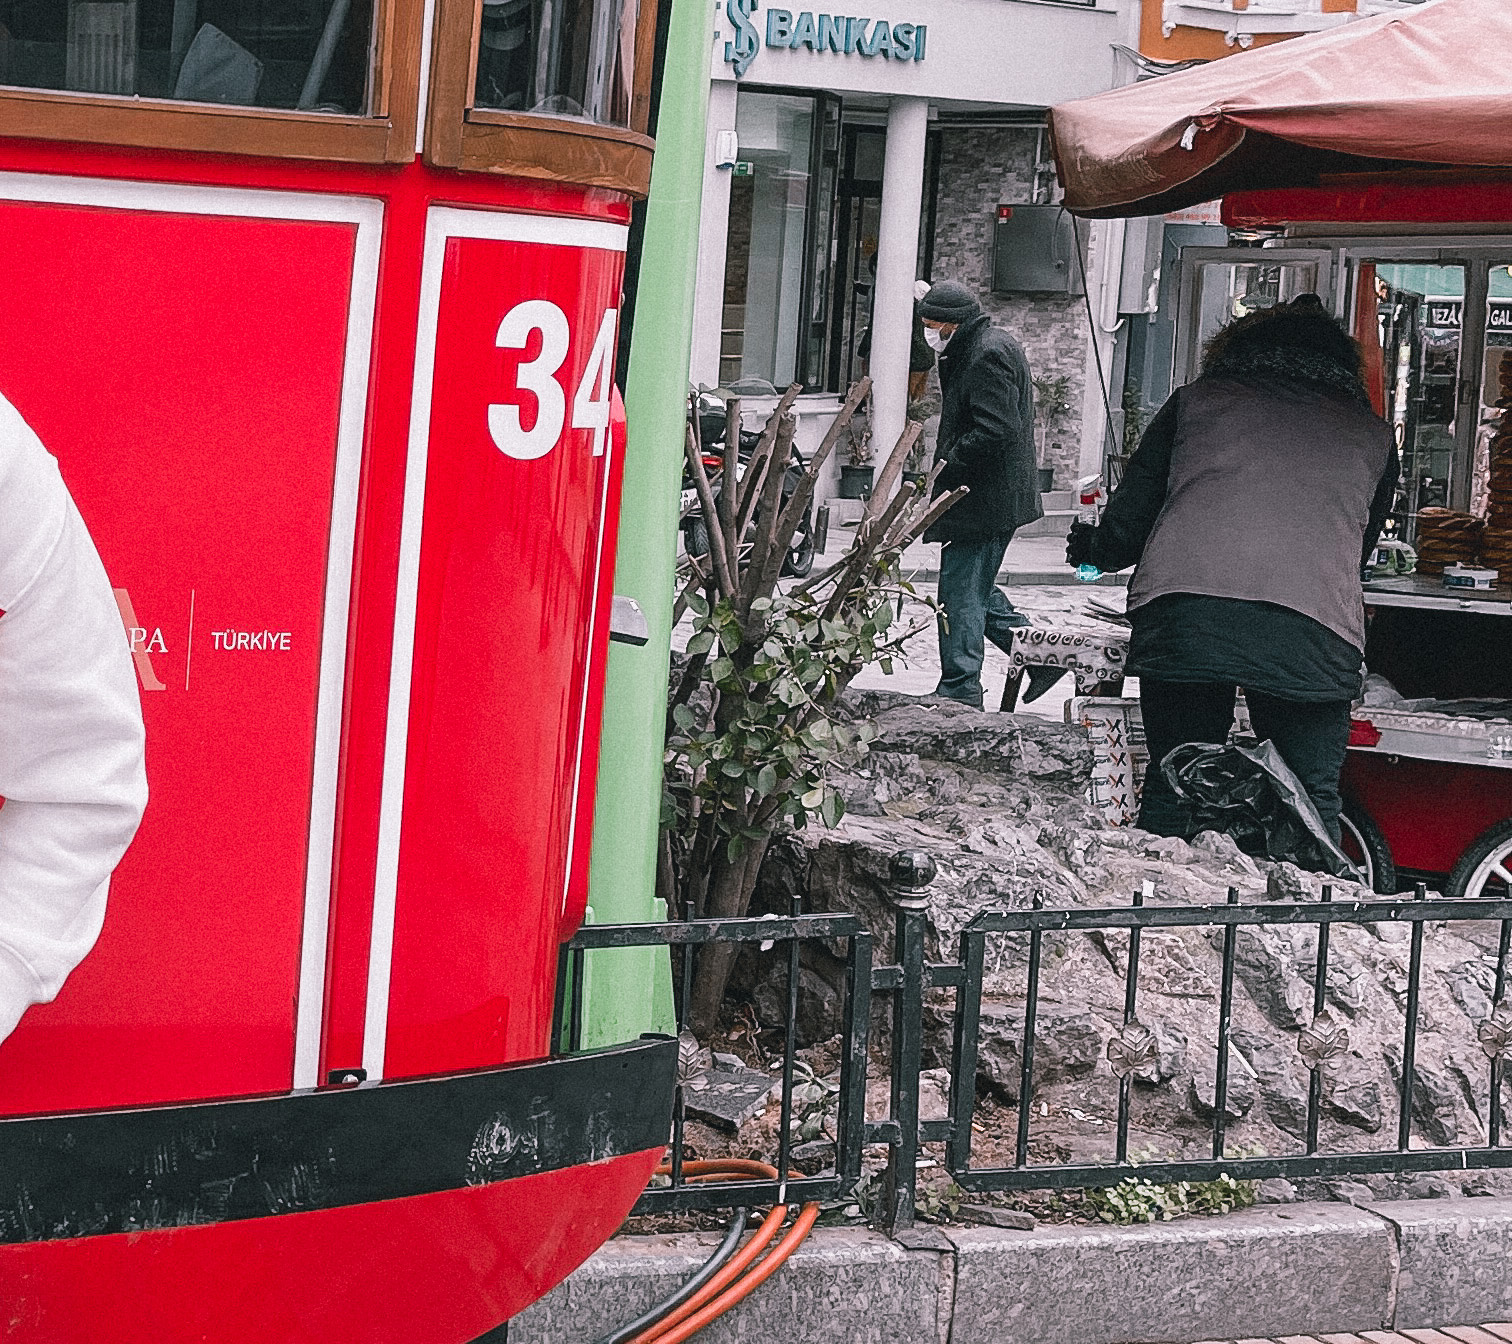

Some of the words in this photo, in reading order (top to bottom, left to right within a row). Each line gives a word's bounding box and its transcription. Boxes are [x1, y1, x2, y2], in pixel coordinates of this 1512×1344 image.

[765, 8, 928, 63] BANKASI
[488, 299, 618, 461] 34
[211, 629, 292, 651] TÜRKİYE
